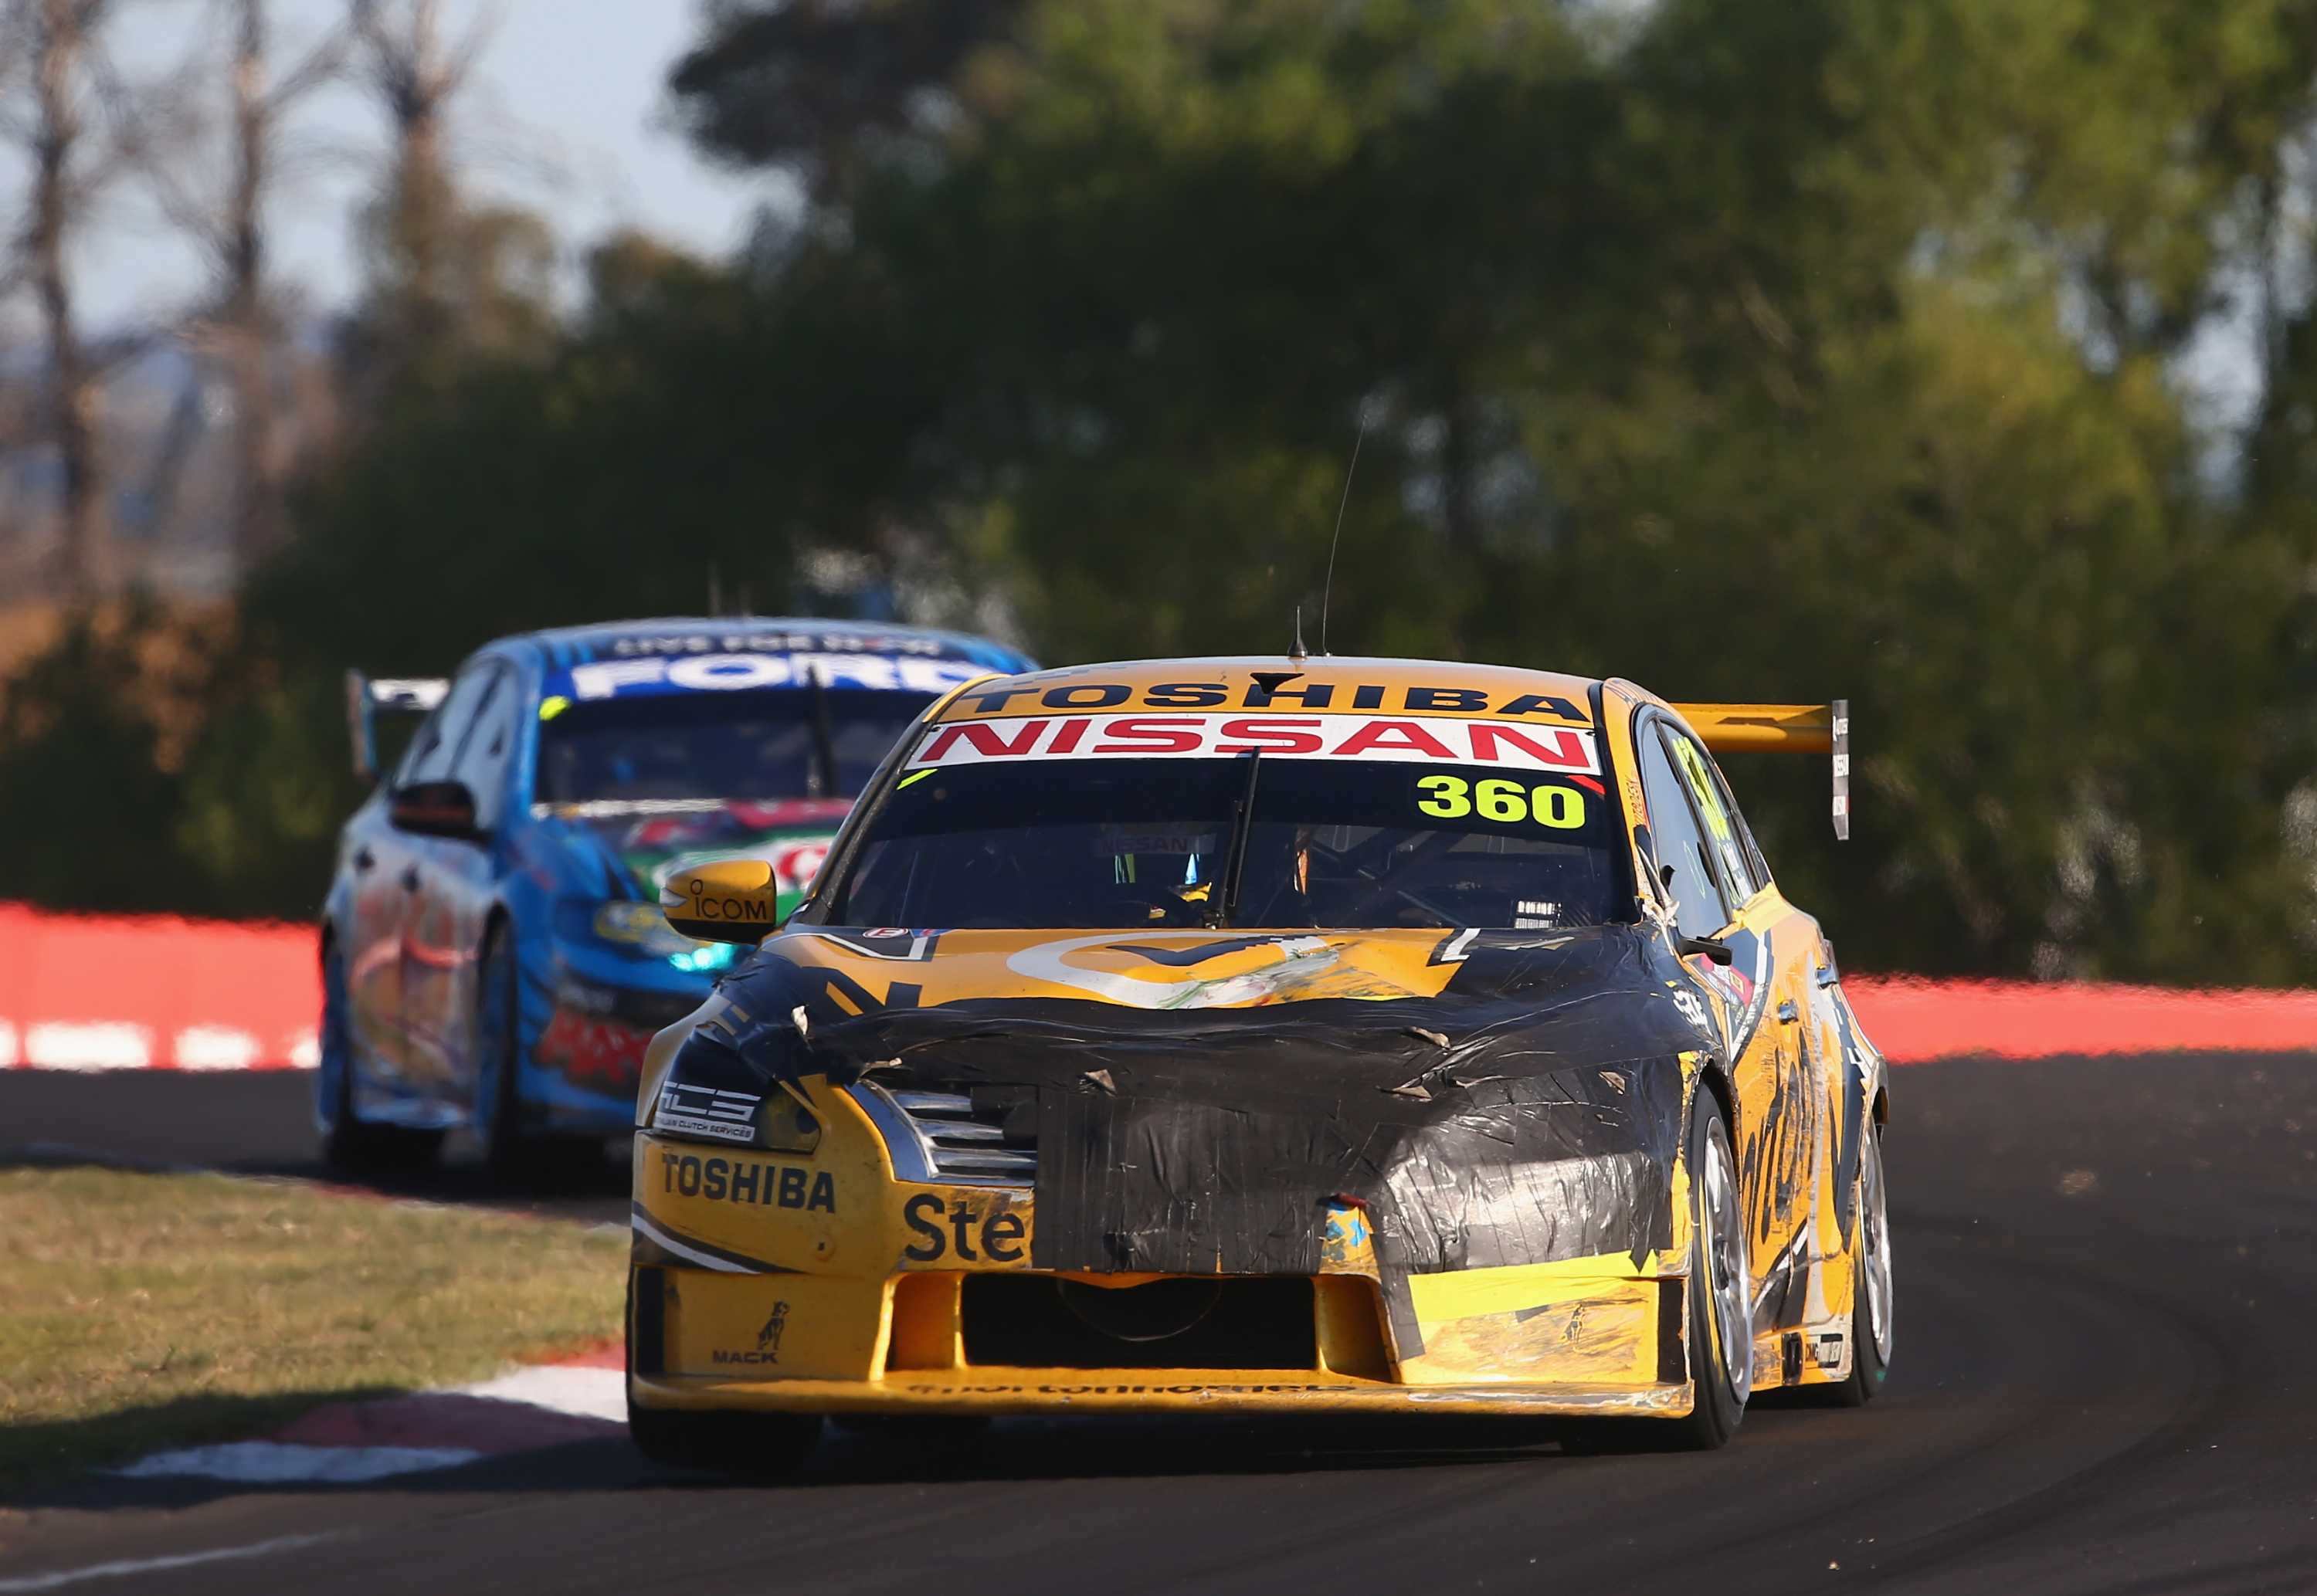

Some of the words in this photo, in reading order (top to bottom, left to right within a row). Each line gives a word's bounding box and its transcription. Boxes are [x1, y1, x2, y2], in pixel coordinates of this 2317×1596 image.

[572, 653, 996, 700] FORD
[958, 683, 1591, 723] TOSHIBA
[918, 719, 1591, 768] NISSAN
[1416, 775, 1585, 829] 360
[678, 1120, 708, 1131] CLUTCH
[710, 1124, 752, 1138] SERVICES
[661, 1154, 836, 1214] TOSHIBA
[904, 1193, 1030, 1262] Ste
[712, 1350, 779, 1364] MACK
